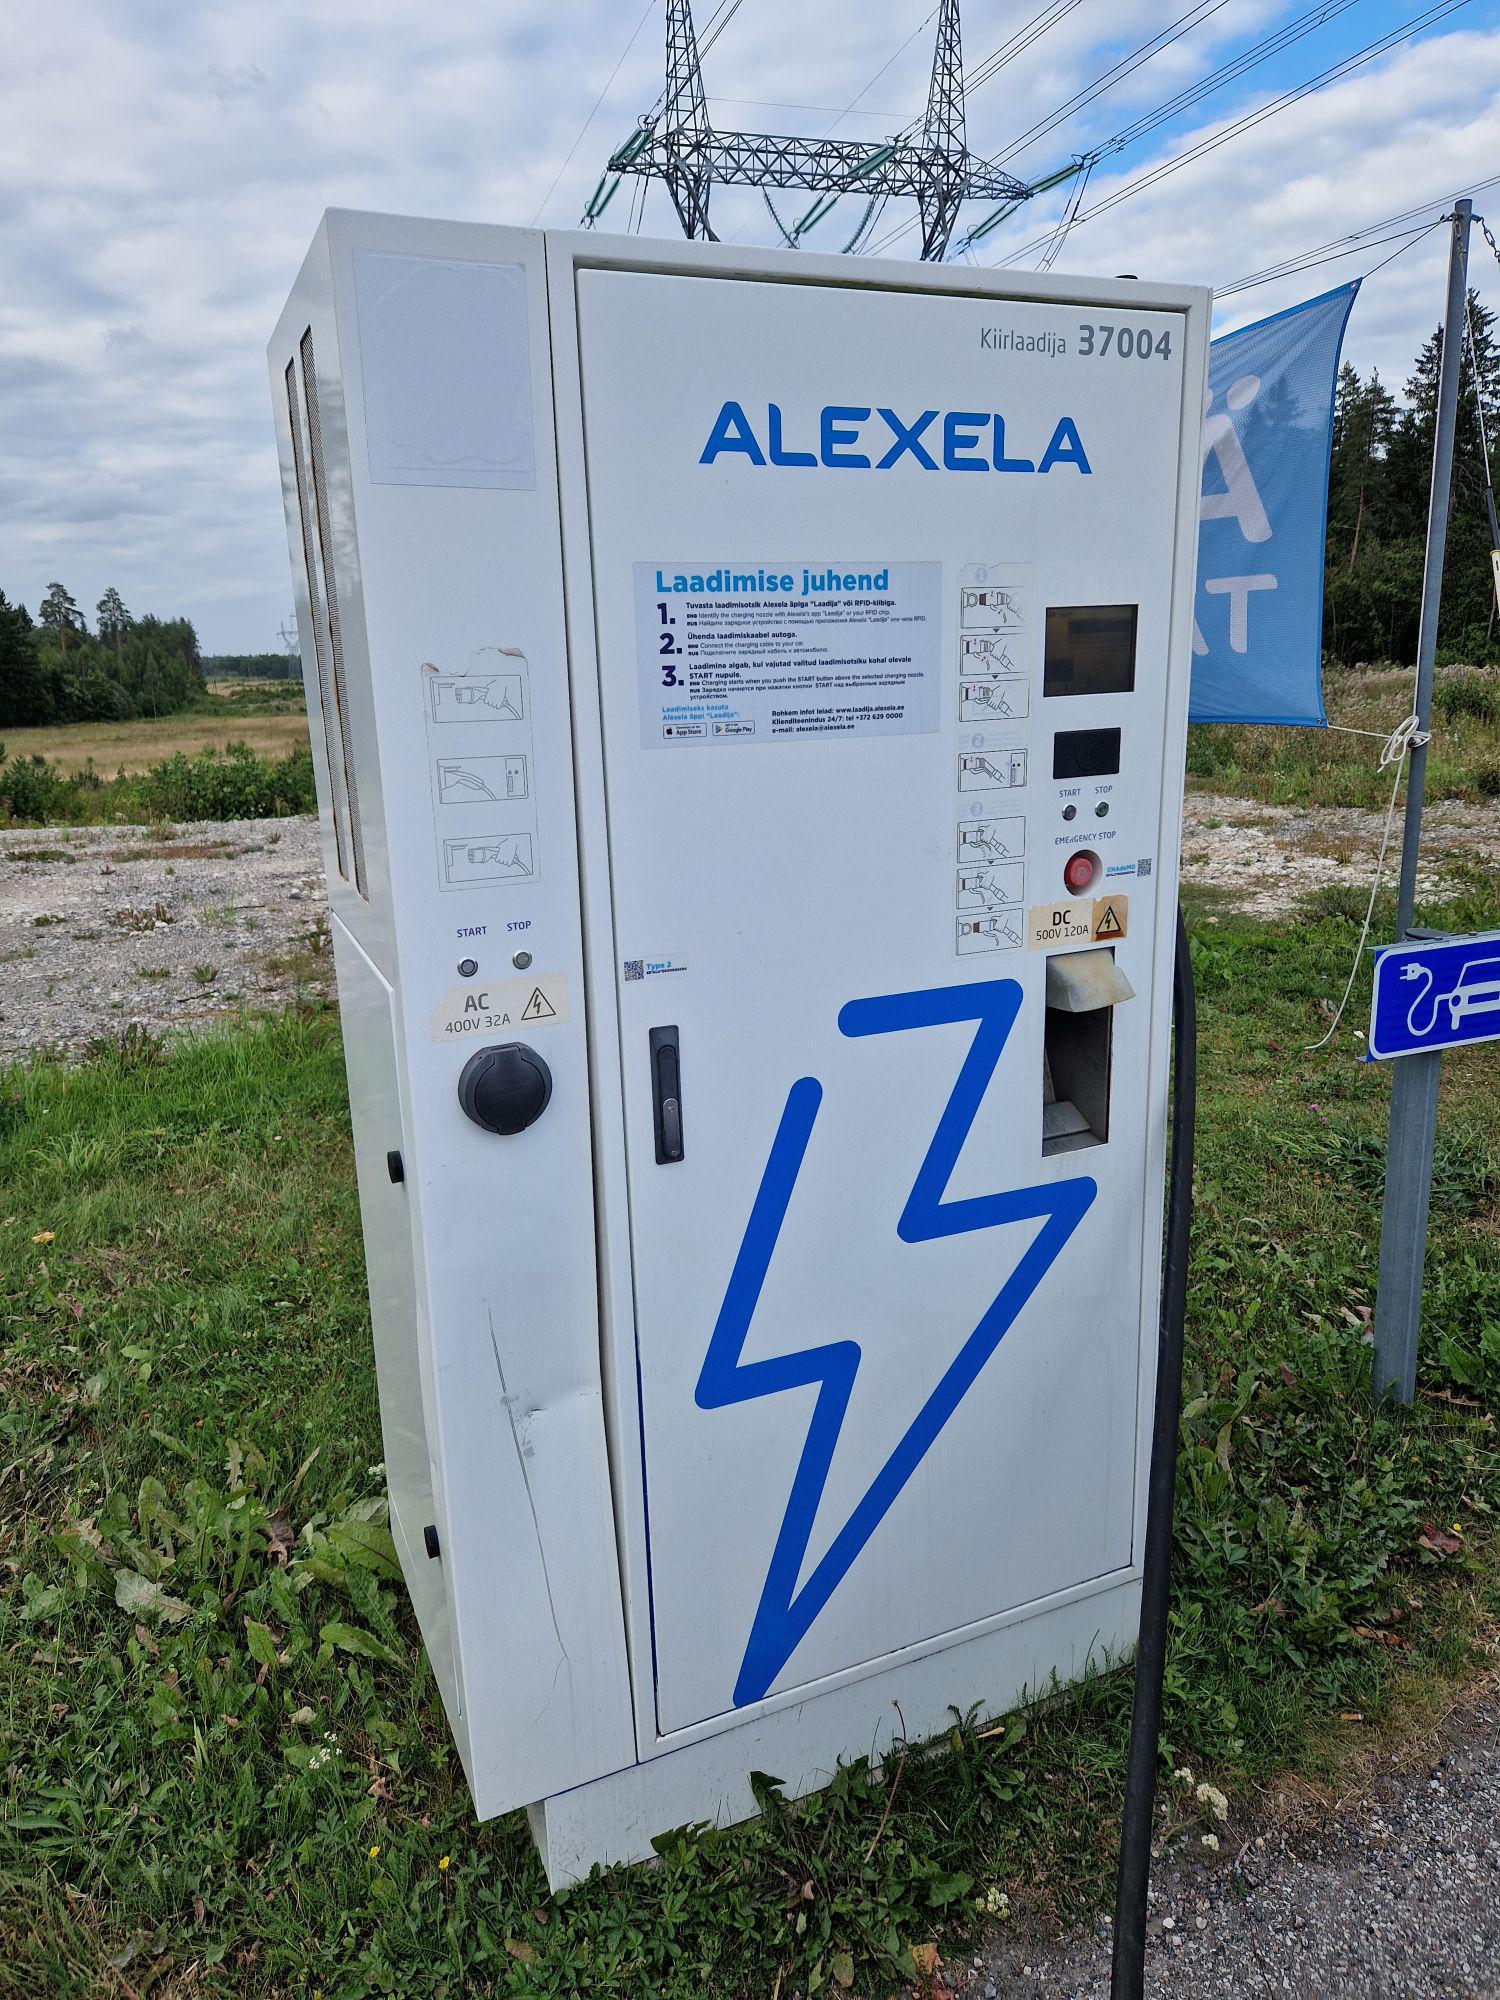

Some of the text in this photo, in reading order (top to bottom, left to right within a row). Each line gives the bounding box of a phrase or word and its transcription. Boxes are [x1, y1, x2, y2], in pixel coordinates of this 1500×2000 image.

[980, 324, 1172, 361] Kiirlaadija 37004
[699, 401, 1093, 474] ALEXELA
[656, 569, 889, 596] Laadimise juhend
[714, 601, 761, 609] laadimisotsik
[854, 599, 896, 608] RFID-kiibiga.
[657, 602, 676, 624] 1.
[687, 631, 798, 640] Ühenda laadimiskaabel autoga.
[659, 633, 683, 654] 2.
[689, 662, 727, 670] Laadimine
[728, 661, 751, 670] algab,
[765, 660, 792, 669] vajutad
[818, 657, 867, 666] laadimisotsiku
[888, 656, 912, 664] olevale
[661, 665, 685, 687] 3.
[689, 671, 742, 680] START nupule.
[662, 705, 705, 713] Laadimiseks
[772, 709, 798, 717] Rohkem
[772, 716, 826, 726] Klienditeenindus
[827, 715, 844, 723] 24/7:
[724, 726, 741, 734] Google
[1059, 789, 1081, 798] START
[1094, 786, 1112, 794] STOP
[1098, 831, 1116, 840] STOP
[1107, 864, 1136, 872] CHAdeMO
[1052, 910, 1071, 926] DC
[456, 926, 487, 938] START
[506, 920, 532, 932] STOP
[1036, 925, 1088, 940] 500V 120A
[464, 993, 490, 1012] AC
[445, 1014, 510, 1034] 400V 32A
